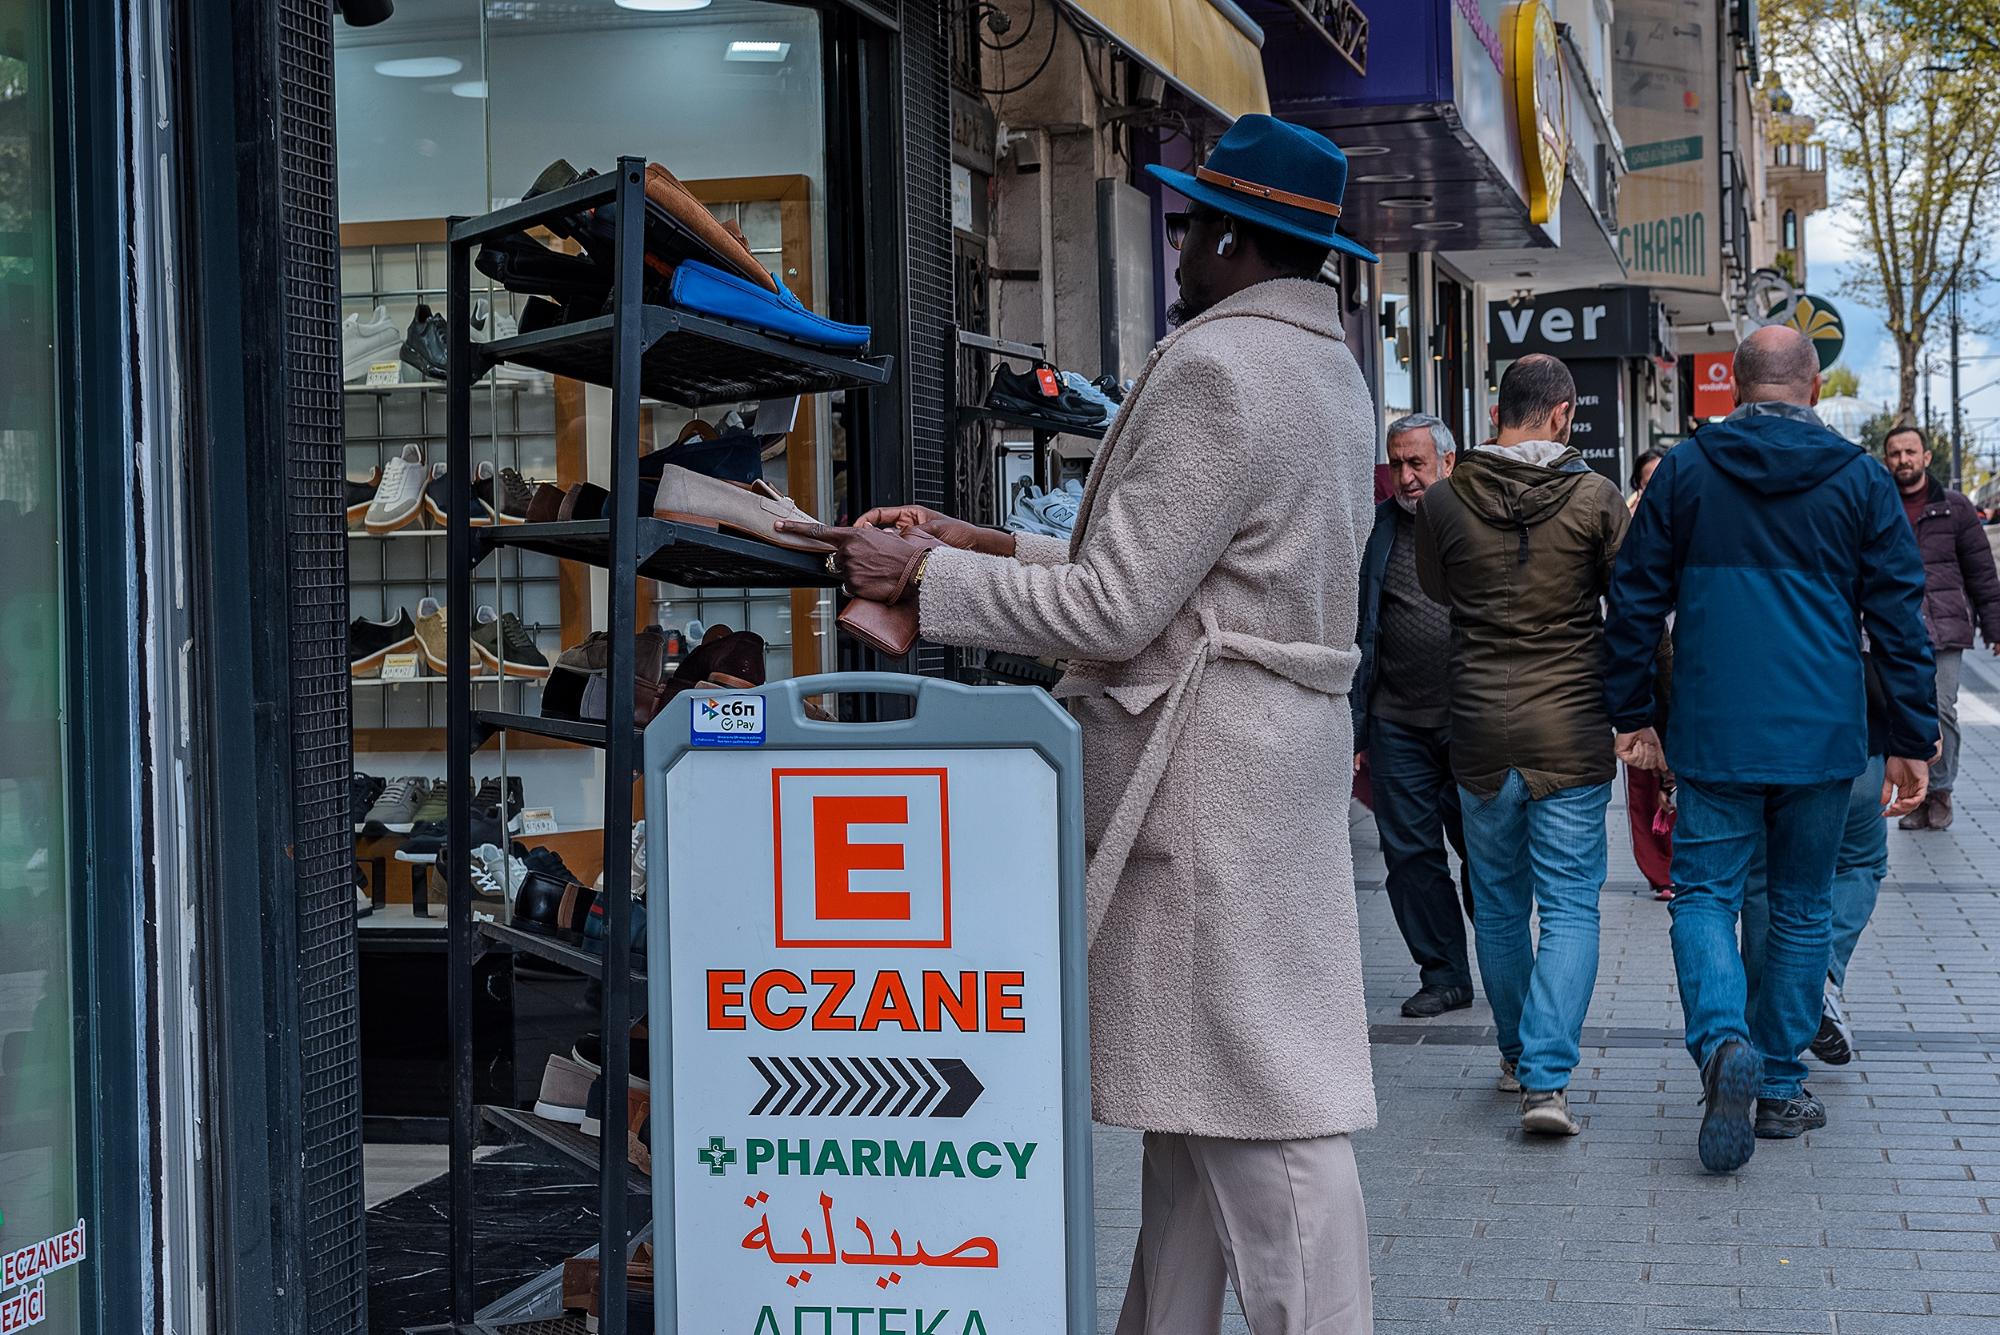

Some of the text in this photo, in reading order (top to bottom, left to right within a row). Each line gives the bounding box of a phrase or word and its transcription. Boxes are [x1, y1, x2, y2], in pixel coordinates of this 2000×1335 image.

[1498, 305, 1607, 343] ver
[721, 701, 754, 716] сбп
[736, 720, 754, 731] Pay
[812, 795, 911, 921] E
[706, 968, 1026, 1034] ECZANE
[745, 1137, 1038, 1180] PHARMACY
[4, 1219, 84, 1286] ECZANESİ
[741, 1190, 999, 1290] صيدلية
